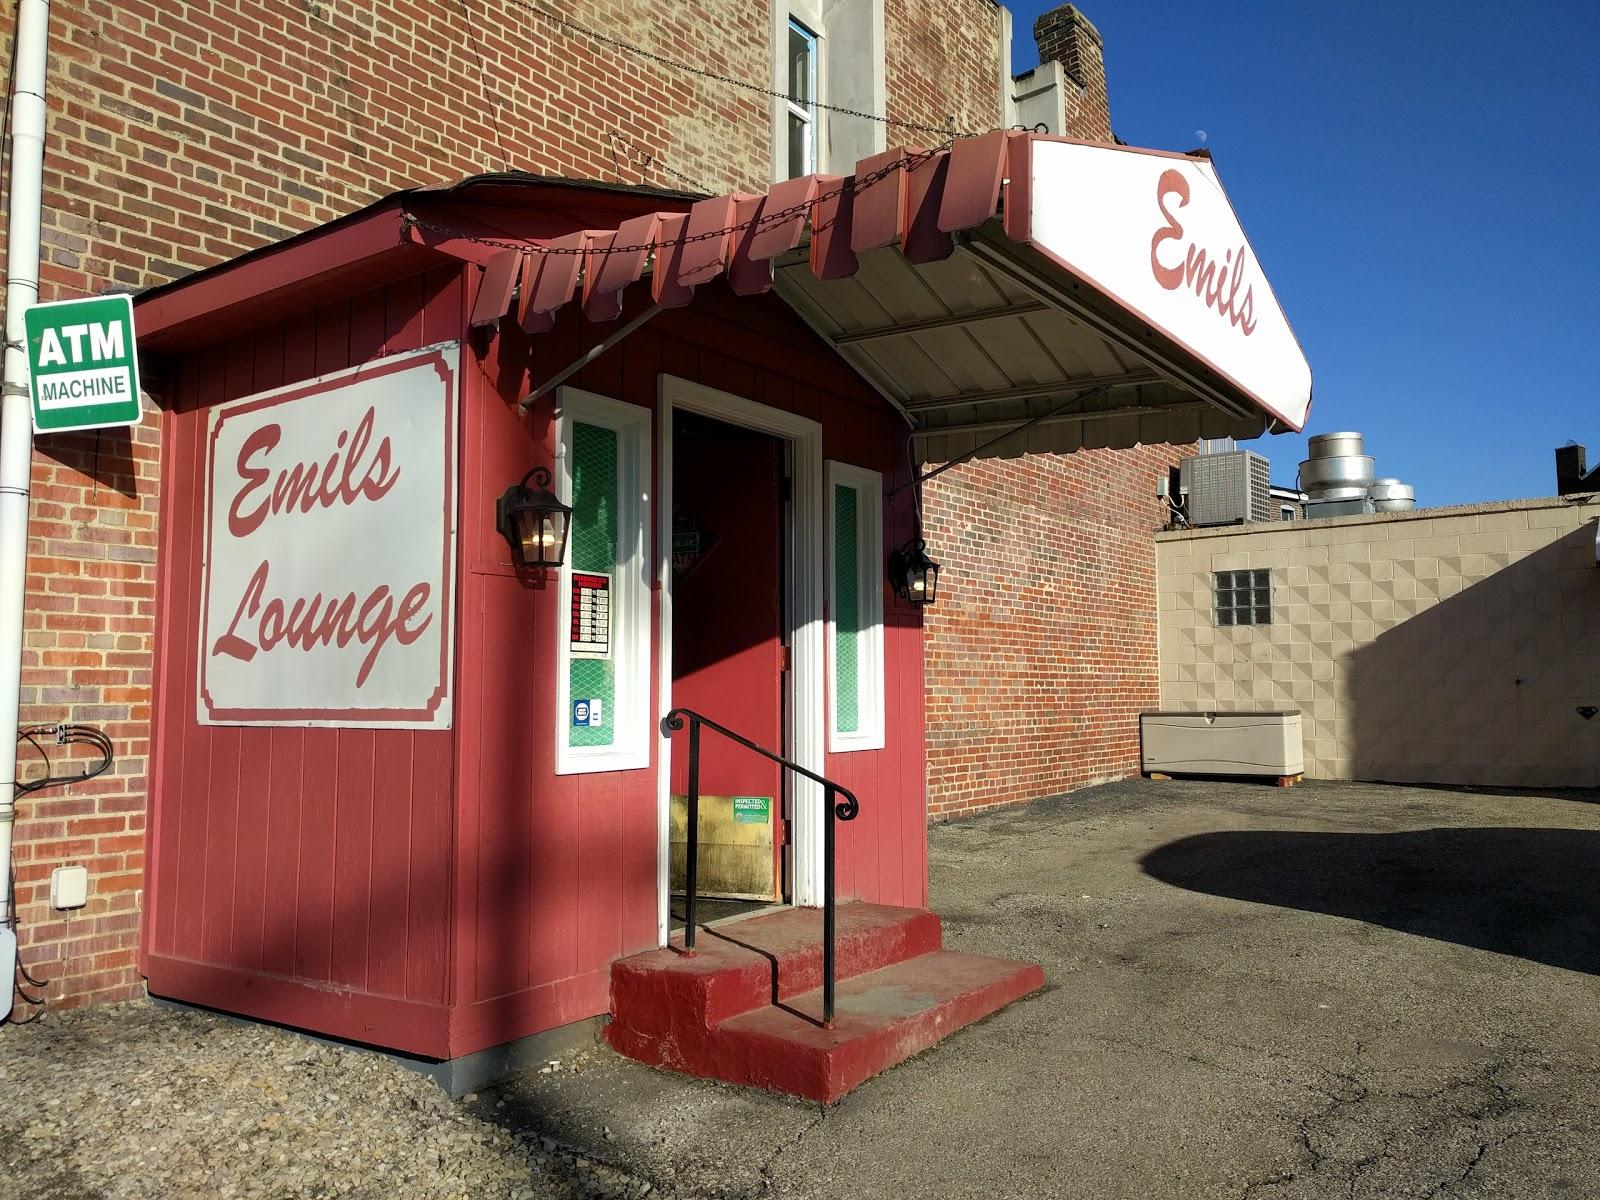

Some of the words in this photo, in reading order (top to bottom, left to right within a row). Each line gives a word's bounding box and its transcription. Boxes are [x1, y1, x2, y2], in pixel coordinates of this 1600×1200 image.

[1151, 168, 1257, 336] Emils
[38, 320, 126, 367] ATM
[41, 376, 126, 401] MACHINE
[228, 406, 401, 538] Emils
[212, 560, 434, 689] Lounge
